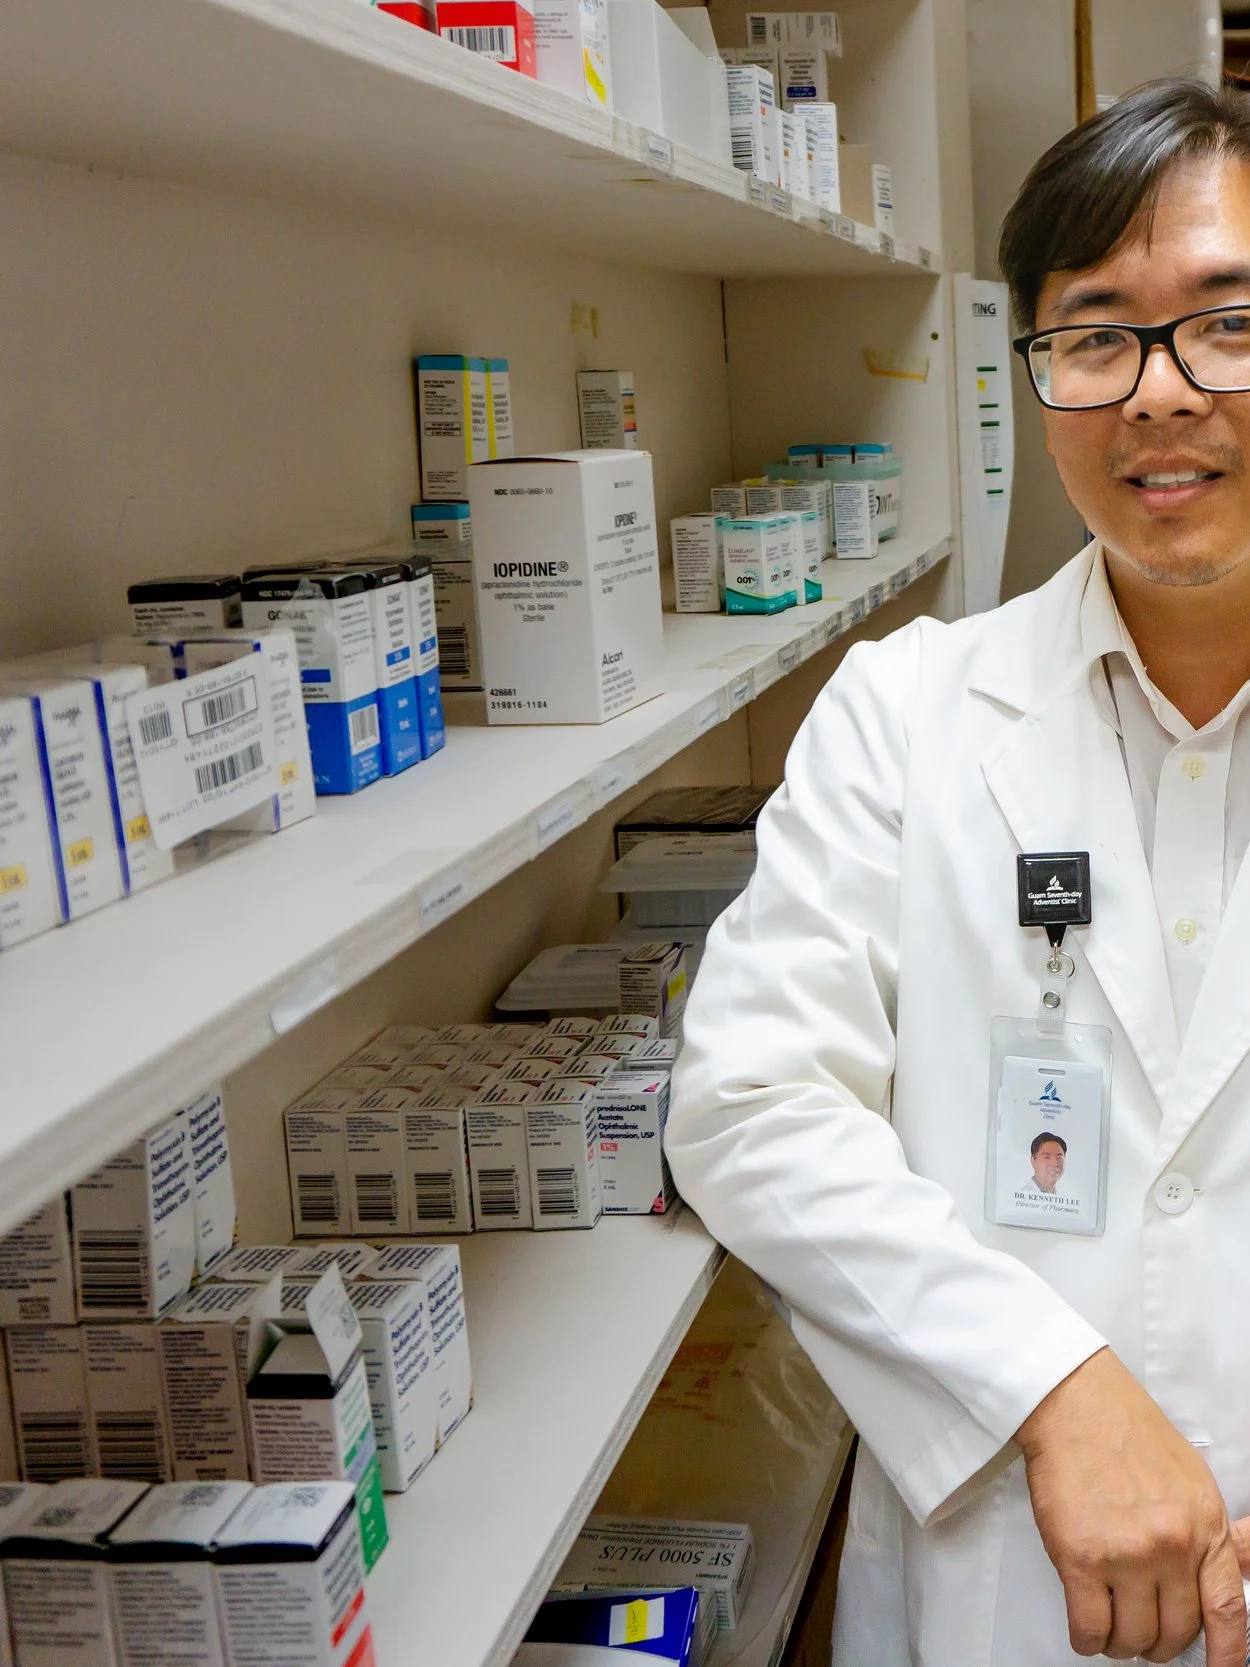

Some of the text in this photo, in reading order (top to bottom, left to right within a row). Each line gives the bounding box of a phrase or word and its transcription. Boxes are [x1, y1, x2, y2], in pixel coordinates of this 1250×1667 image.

[1047, 891, 1082, 899] Seventh-day
[597, 1105, 647, 1113] prednisoLONE
[1028, 1194, 1064, 1204] KENNETH
[1066, 1198, 1080, 1206] LEE
[1016, 1200, 1040, 1209] Director
[1049, 1205, 1079, 1214] Pharmacy
[599, 1545, 734, 1567] SF 5000 PLUS
